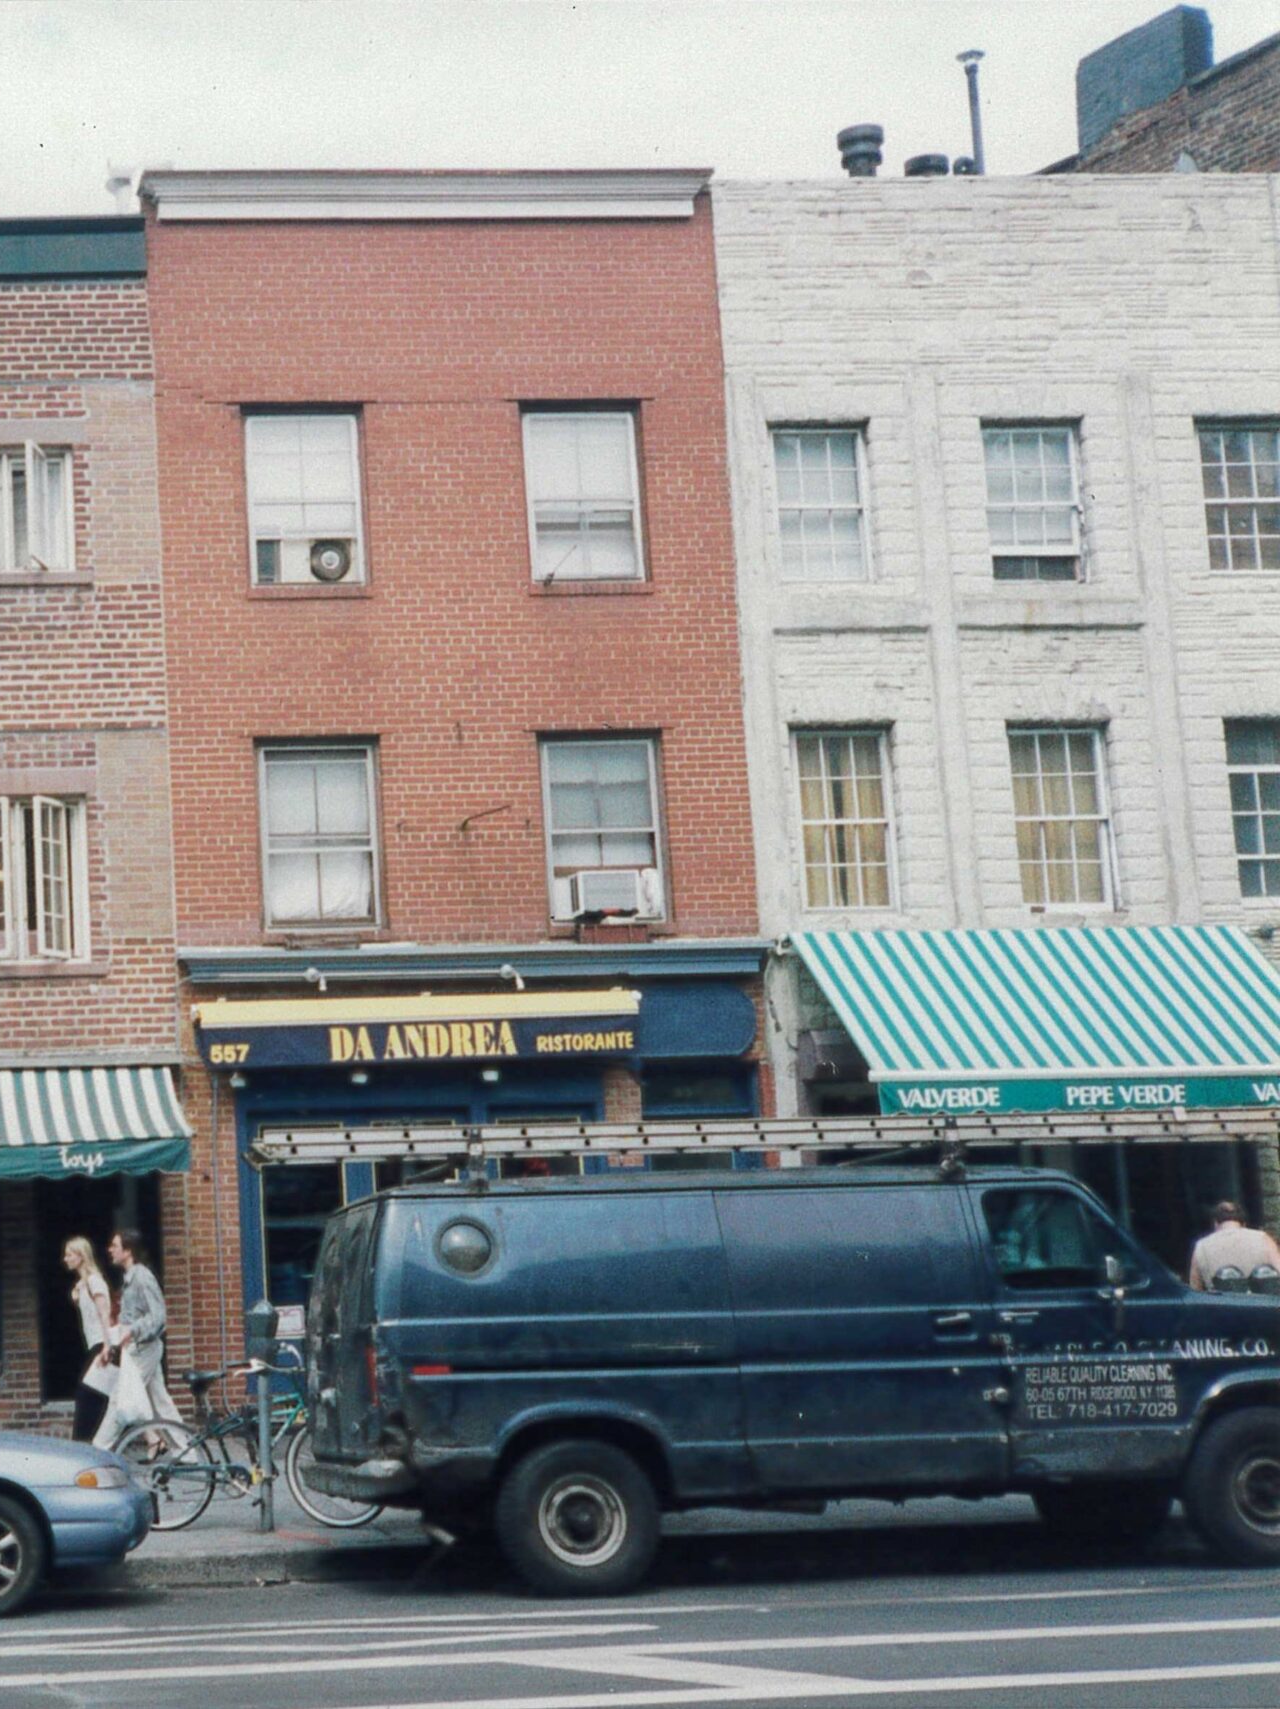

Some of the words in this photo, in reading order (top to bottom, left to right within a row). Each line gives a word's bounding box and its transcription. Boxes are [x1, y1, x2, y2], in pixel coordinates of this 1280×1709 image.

[329, 1026, 375, 1062] DA
[383, 1021, 518, 1060] ANDREA
[536, 1031, 635, 1052] RISTORANTE
[210, 1043, 250, 1064] 557
[897, 1086, 1000, 1108] VALVERDE
[1065, 1085, 1114, 1106] PEPE
[1118, 1084, 1186, 1104] VERDE
[1252, 1082, 1280, 1102] VA
[1025, 1366, 1068, 1384] RELIABLE
[1069, 1364, 1108, 1383] QUALITY
[1109, 1363, 1156, 1382] CLEANING
[1056, 1386, 1087, 1401] 67TH
[1068, 1401, 1178, 1418] 718-417-7029
